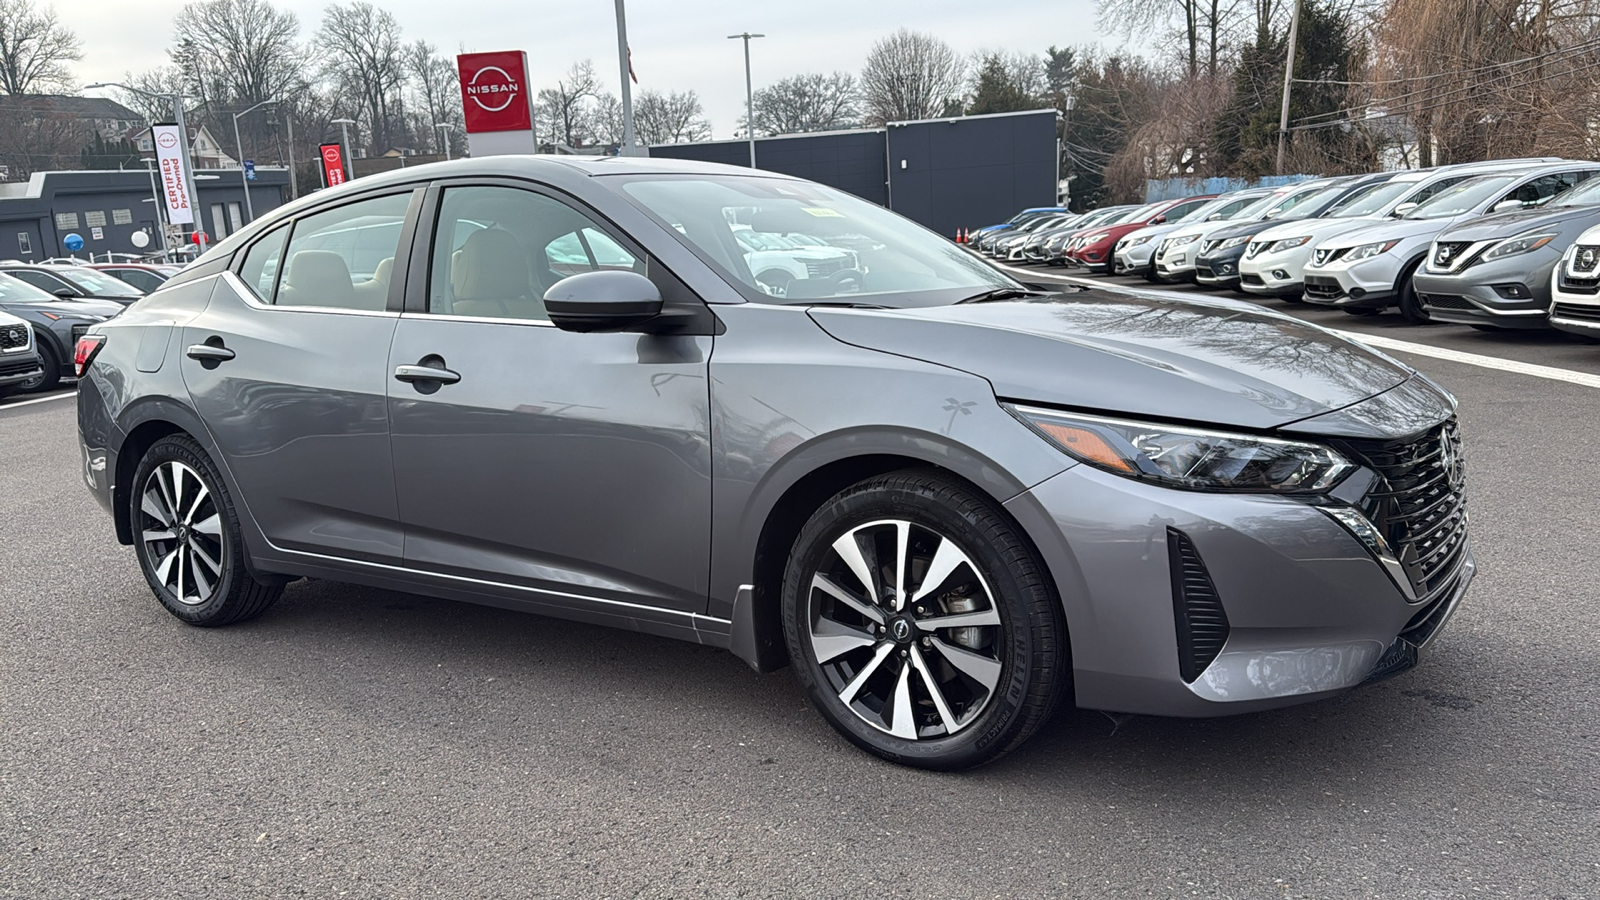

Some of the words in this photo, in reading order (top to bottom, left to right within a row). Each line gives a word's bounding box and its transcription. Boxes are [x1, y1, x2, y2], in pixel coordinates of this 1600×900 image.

[467, 83, 518, 94] NISSAN
[162, 158, 179, 209] CERTIFIED
[170, 158, 188, 209] Pre-Owned
[1008, 596, 1027, 701] MICHELIN
[987, 709, 1012, 740] PRIMACY
